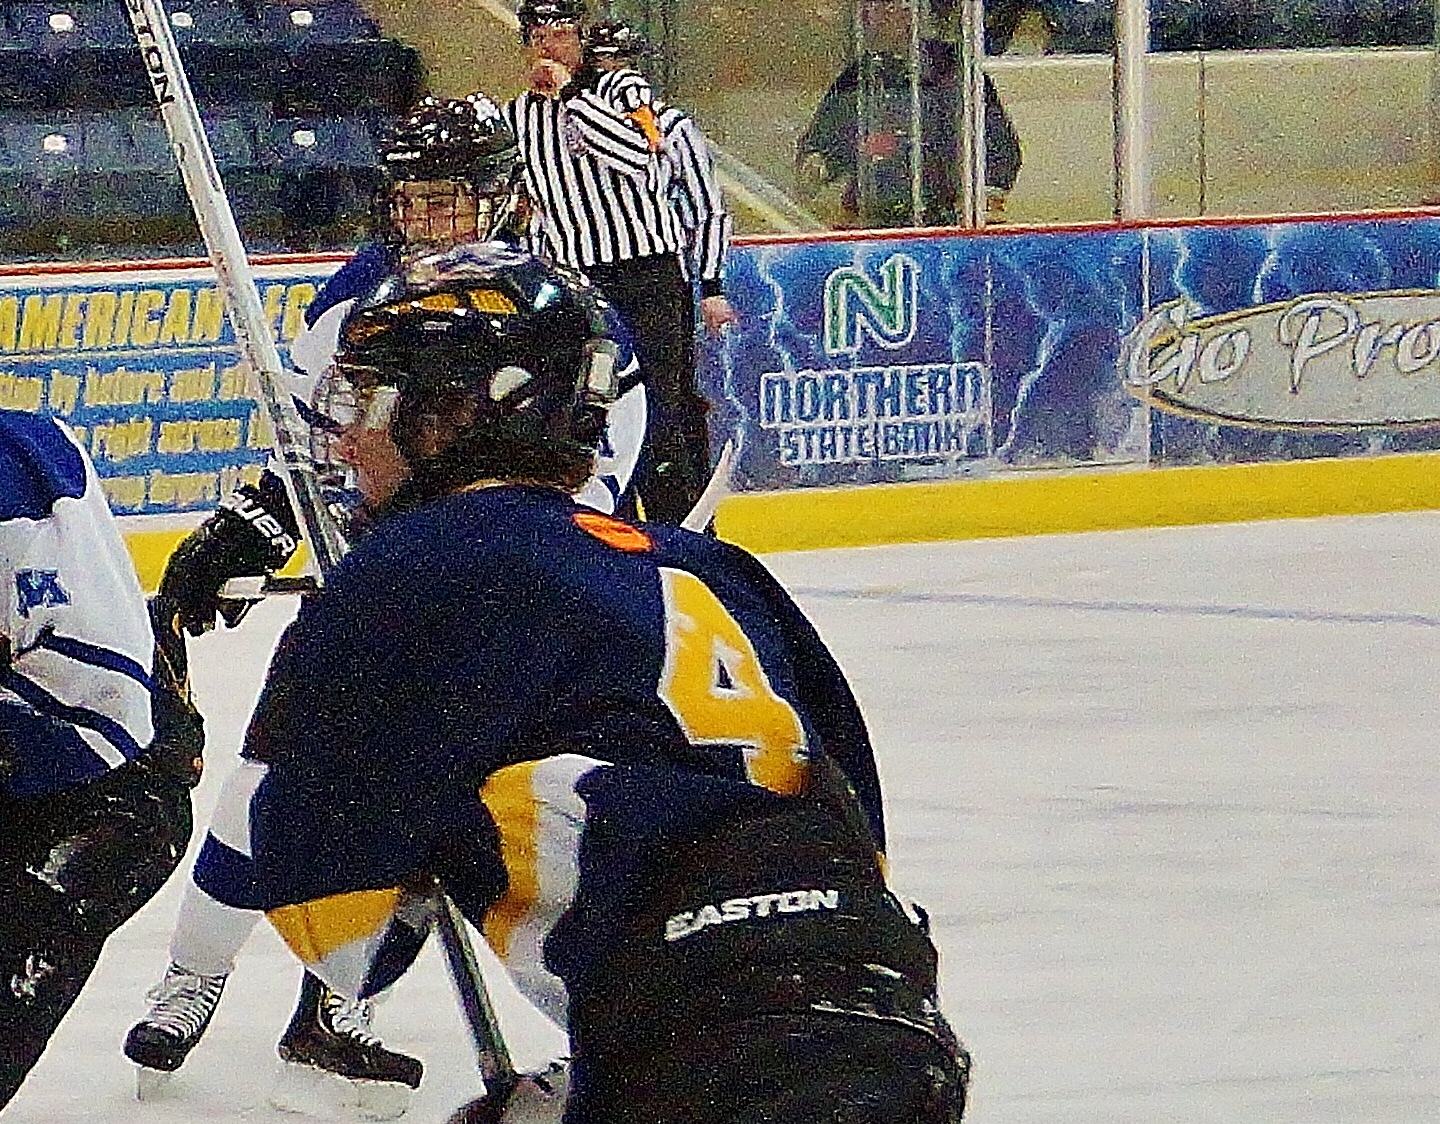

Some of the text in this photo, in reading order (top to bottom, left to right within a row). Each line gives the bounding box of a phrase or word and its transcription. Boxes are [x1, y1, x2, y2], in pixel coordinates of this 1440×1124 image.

[823, 252, 920, 356] N
[1121, 297, 1251, 393] Go
[761, 363, 987, 429] NORTHERN
[657, 566, 809, 797] 4
[664, 889, 840, 942] EASTON
